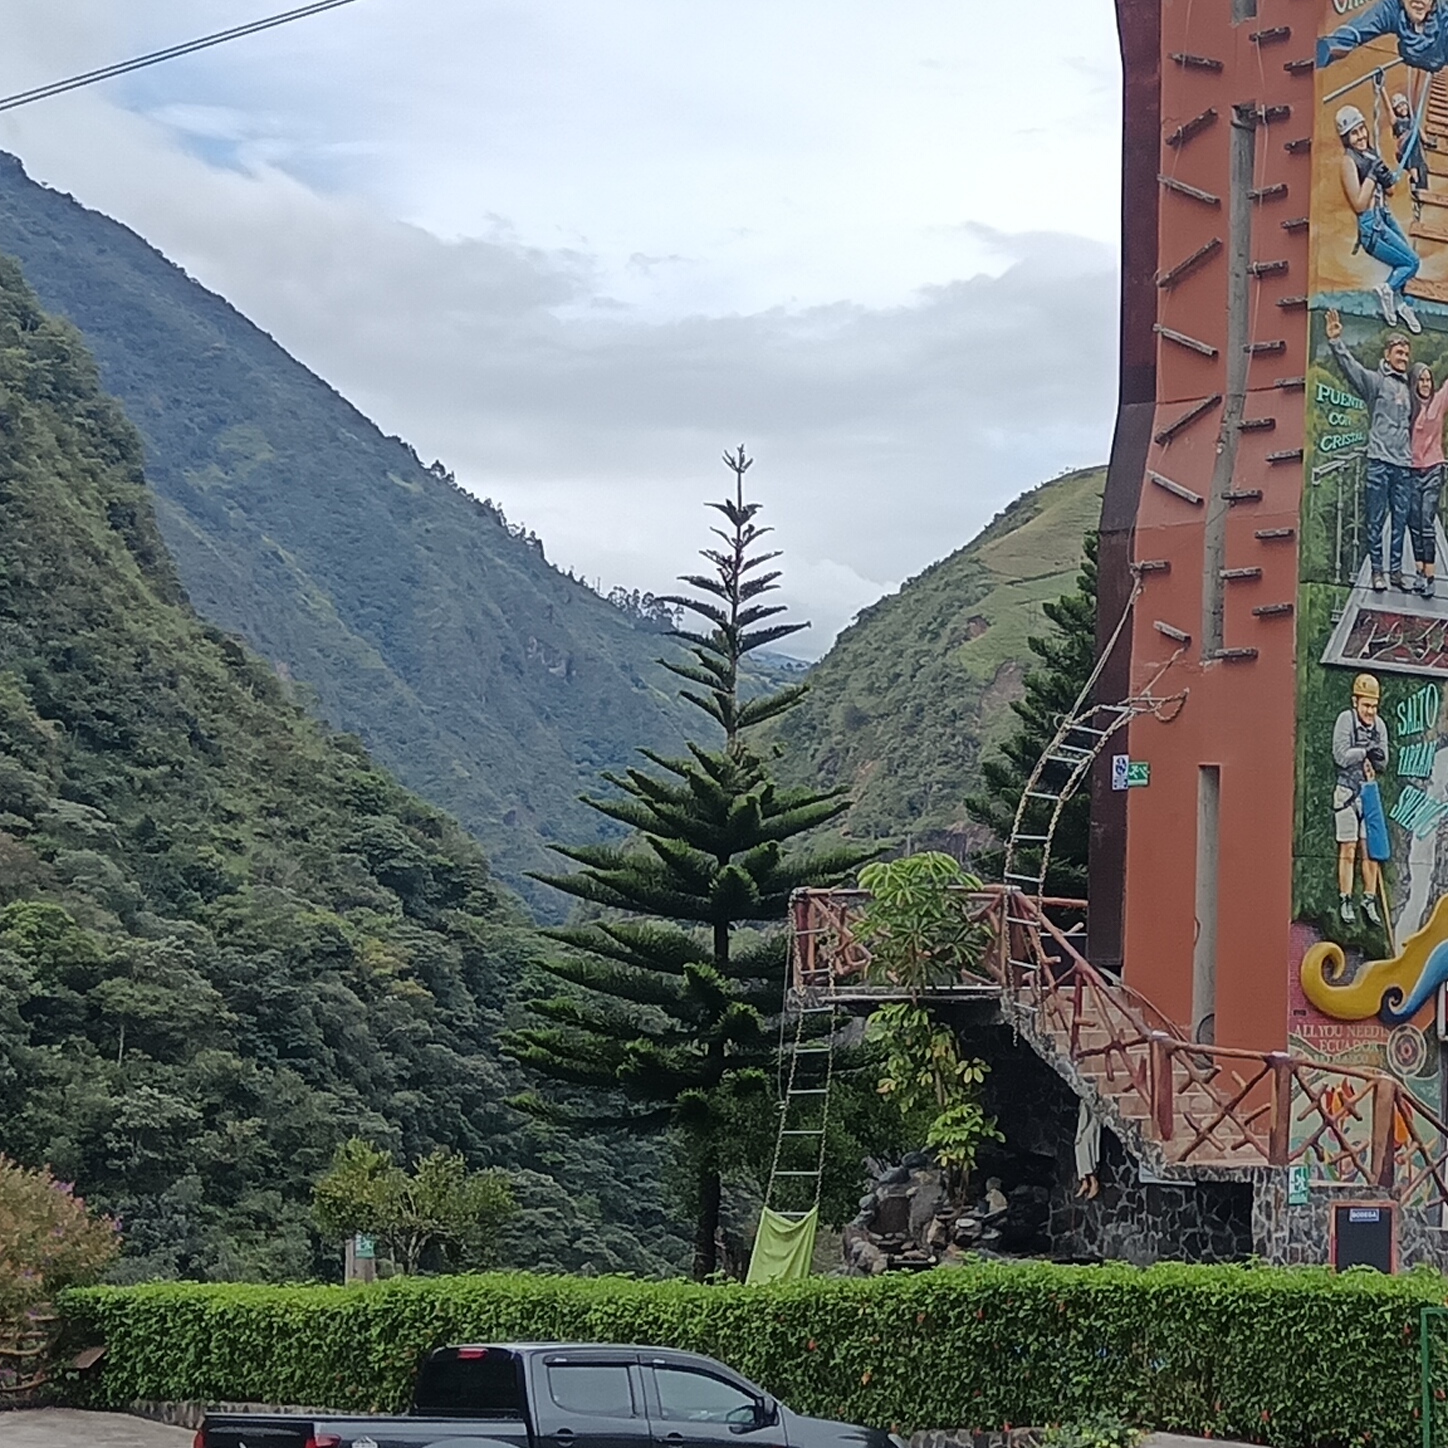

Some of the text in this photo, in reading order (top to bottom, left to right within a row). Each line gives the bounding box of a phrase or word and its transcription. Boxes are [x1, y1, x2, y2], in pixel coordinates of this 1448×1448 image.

[1316, 382, 1365, 409] PUENTE
[1397, 683, 1439, 736] SALTO
[1294, 1024, 1317, 1038] ALL
[1317, 1024, 1343, 1038] YOU
[1347, 1024, 1380, 1038] NEED
[1318, 1038, 1379, 1053] ECUADOR
